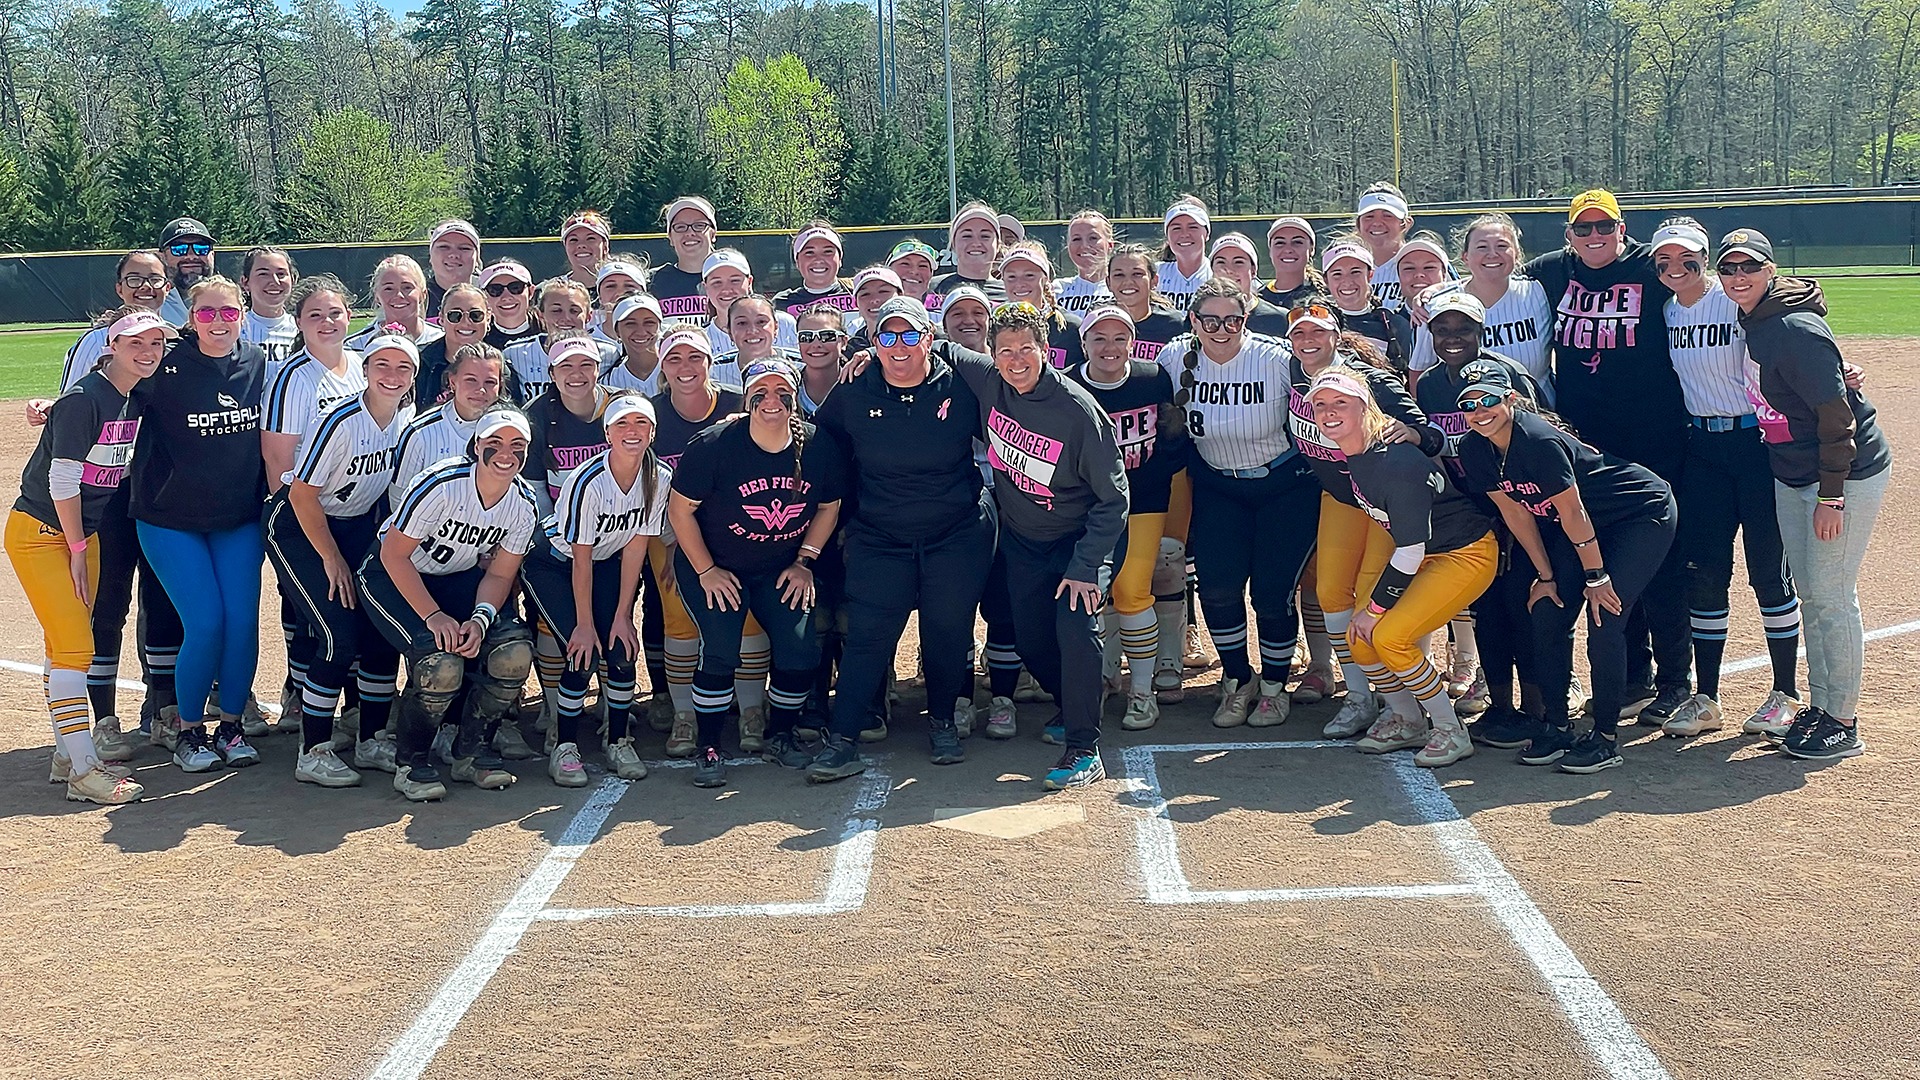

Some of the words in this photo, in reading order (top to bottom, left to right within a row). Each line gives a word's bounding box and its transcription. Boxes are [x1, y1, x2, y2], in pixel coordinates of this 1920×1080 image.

[663, 298, 708, 314] STRONG
[1567, 284, 1629, 313] HOPE
[1482, 317, 1538, 349] CKTON
[1668, 322, 1732, 350] TOCKTON
[1191, 381, 1265, 406] TOCKTON
[187, 405, 260, 428] SOFTBALL
[200, 421, 257, 437] STOCKTON
[1189, 409, 1205, 438] 8
[995, 415, 1051, 459] STRONGER
[1296, 419, 1322, 444] THAN
[346, 446, 398, 477] STOCKT
[1002, 444, 1028, 473] THAN
[333, 481, 358, 503] 4
[738, 478, 769, 498] HER
[772, 476, 811, 495] FIGT
[728, 522, 746, 536] IS
[746, 532, 770, 542] MY
[1822, 730, 1848, 747] HOKA
